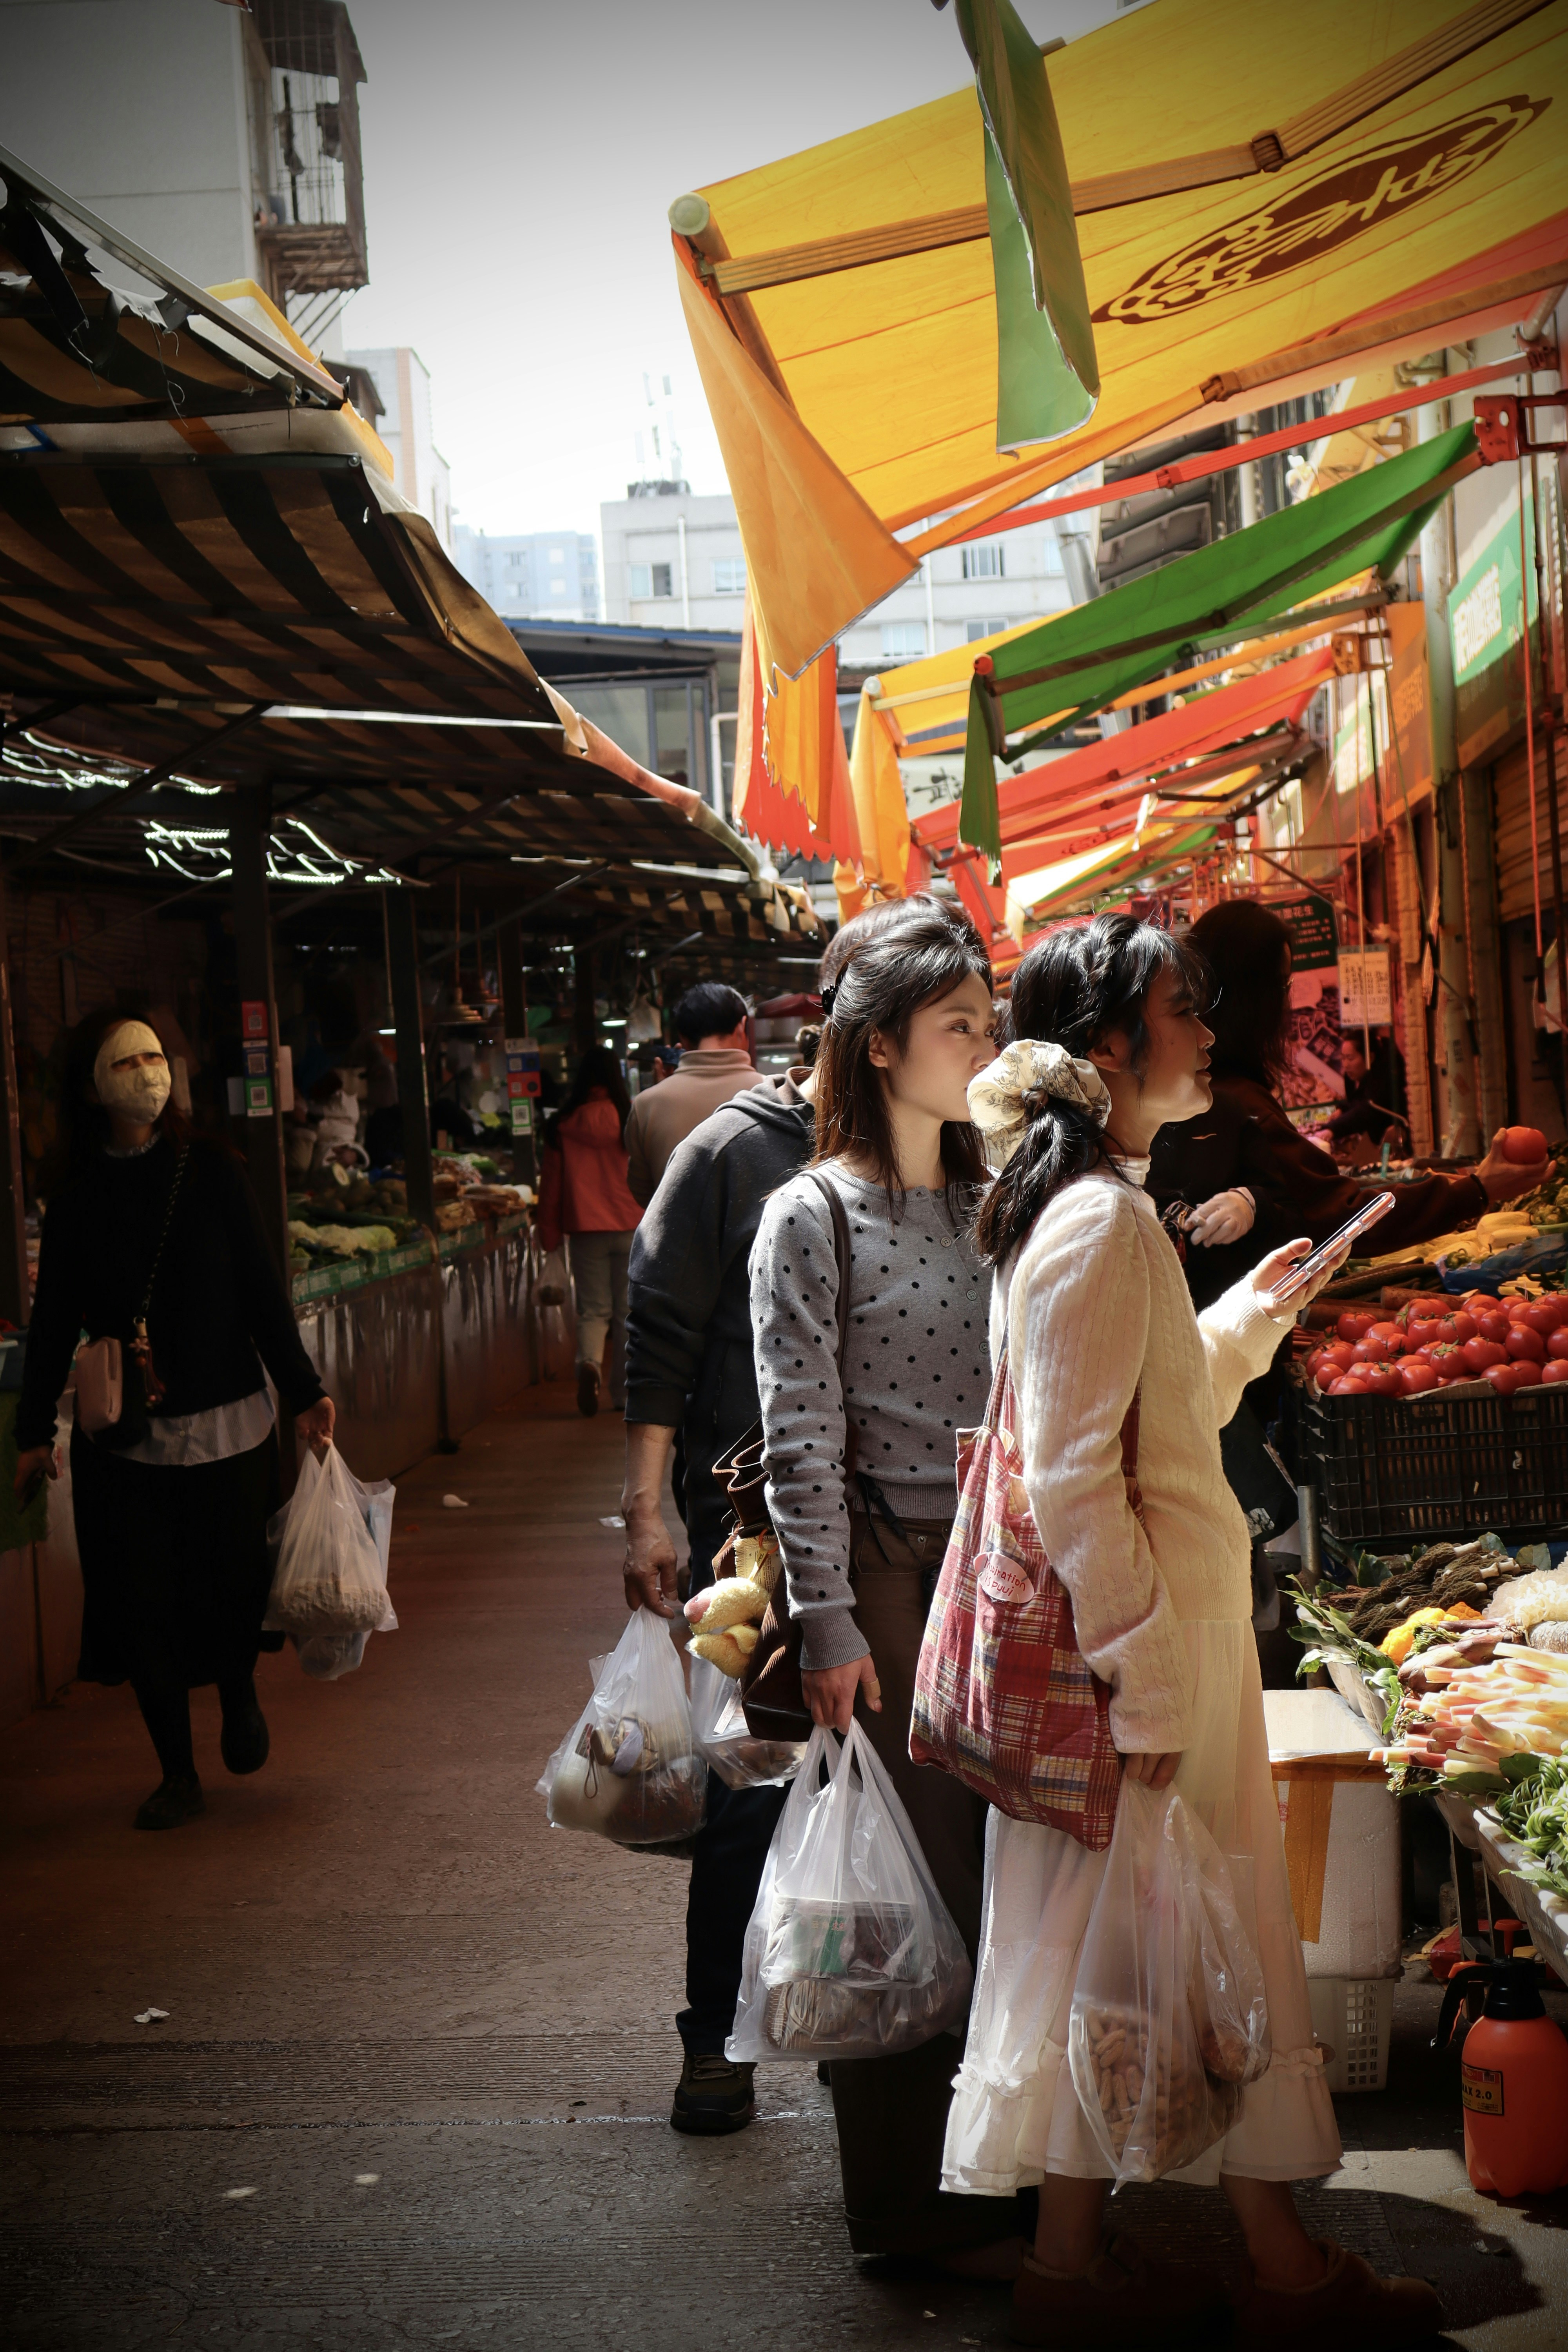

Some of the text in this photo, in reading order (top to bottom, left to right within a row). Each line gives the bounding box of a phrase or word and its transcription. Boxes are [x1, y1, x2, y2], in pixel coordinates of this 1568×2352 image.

[984, 1558, 1026, 1592] Inspiration
[985, 1573, 991, 1586] is
[1475, 2089, 1492, 2100] 2.0
